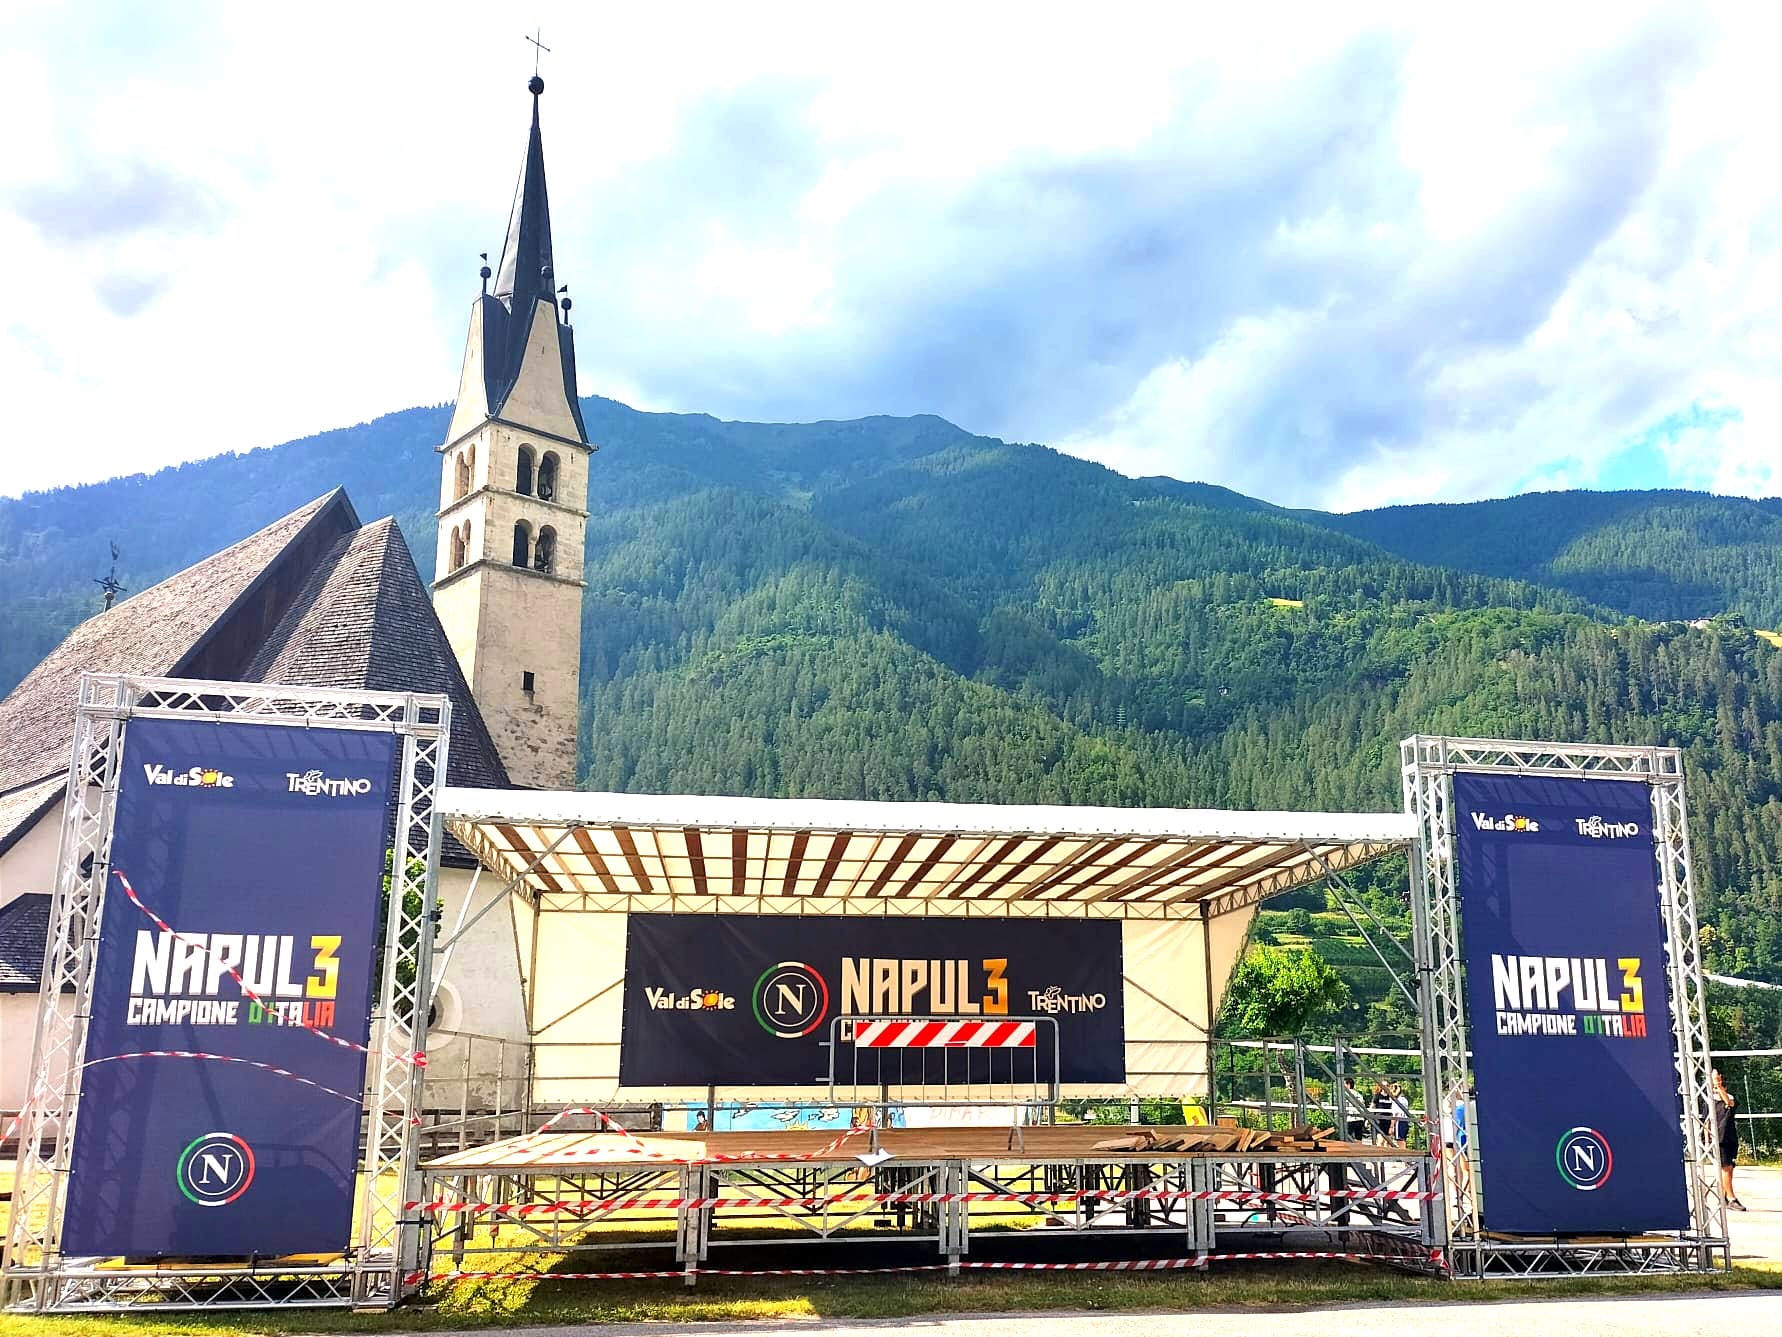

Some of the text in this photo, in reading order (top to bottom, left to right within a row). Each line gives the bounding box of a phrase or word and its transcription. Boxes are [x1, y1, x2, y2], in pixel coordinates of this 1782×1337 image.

[127, 996, 240, 1026] CAMPIONE
[775, 984, 806, 1016] N
[1495, 1011, 1647, 1038] CAMPIONE D'ITALIA
[198, 1154, 233, 1185] N
[1571, 1145, 1595, 1171] N
